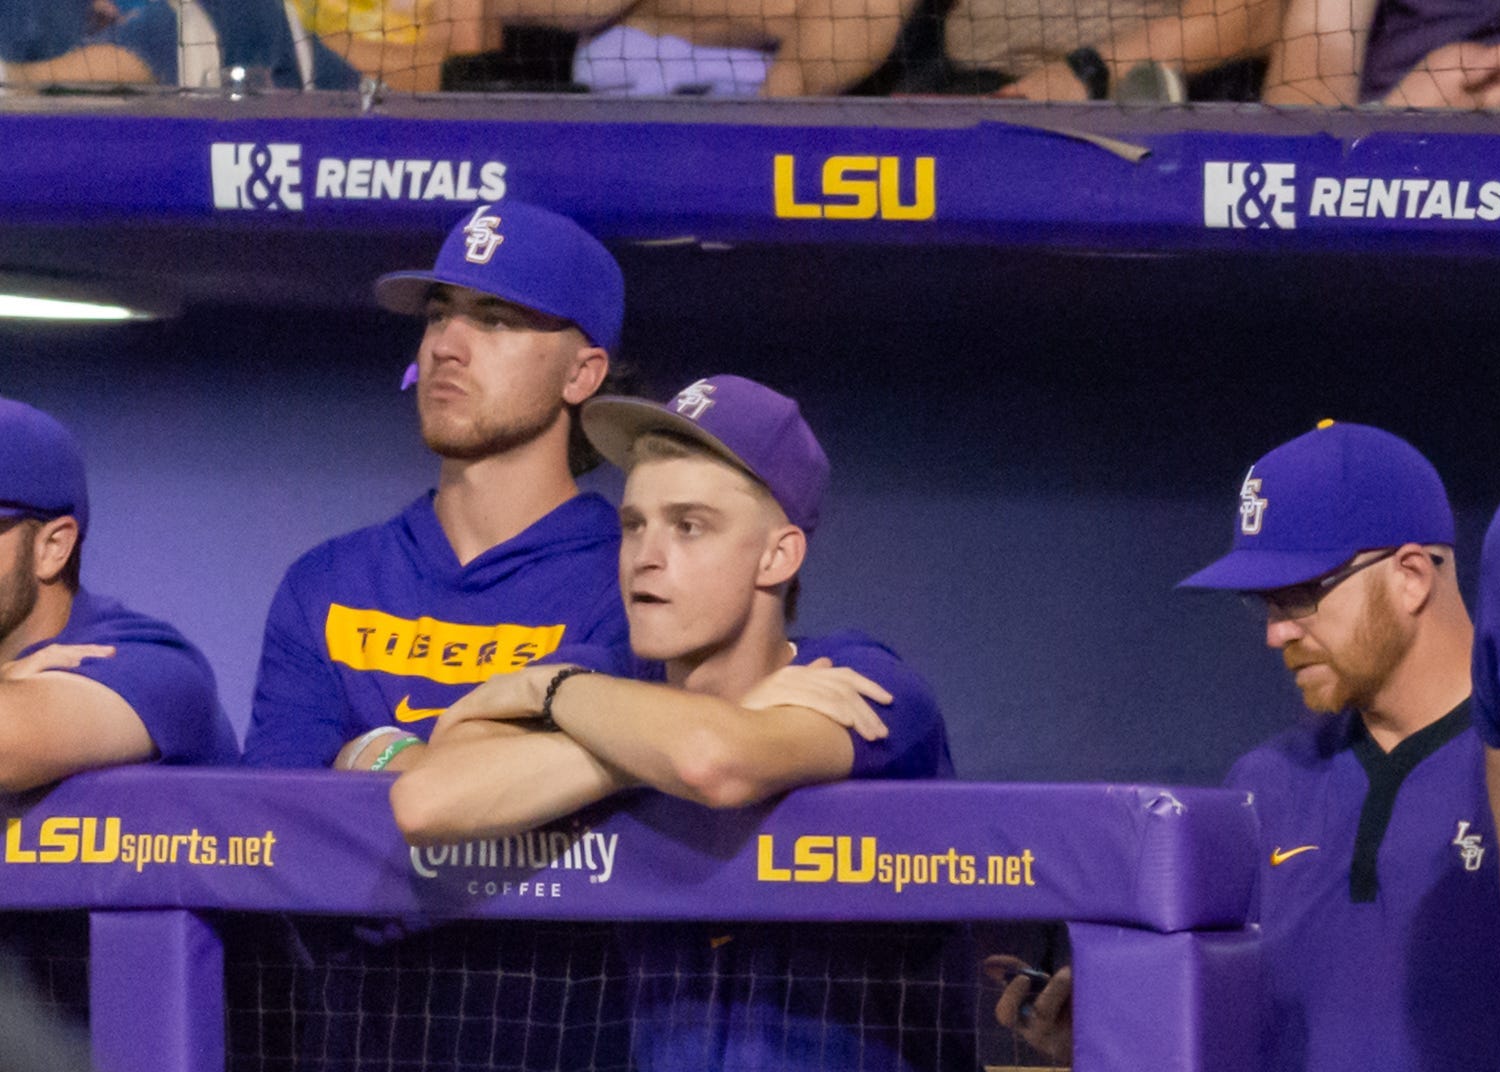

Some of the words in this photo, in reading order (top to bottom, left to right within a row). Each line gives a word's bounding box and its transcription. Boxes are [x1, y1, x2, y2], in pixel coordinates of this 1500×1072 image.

[211, 143, 303, 210] H&E
[315, 158, 507, 202] RENTALS
[774, 155, 935, 220] LSU
[1204, 162, 1296, 229] H&E
[464, 204, 504, 264] LSU
[357, 627, 540, 667] TIGERS
[1453, 821, 1485, 871] LSU
[467, 881, 561, 897] COFFEE
